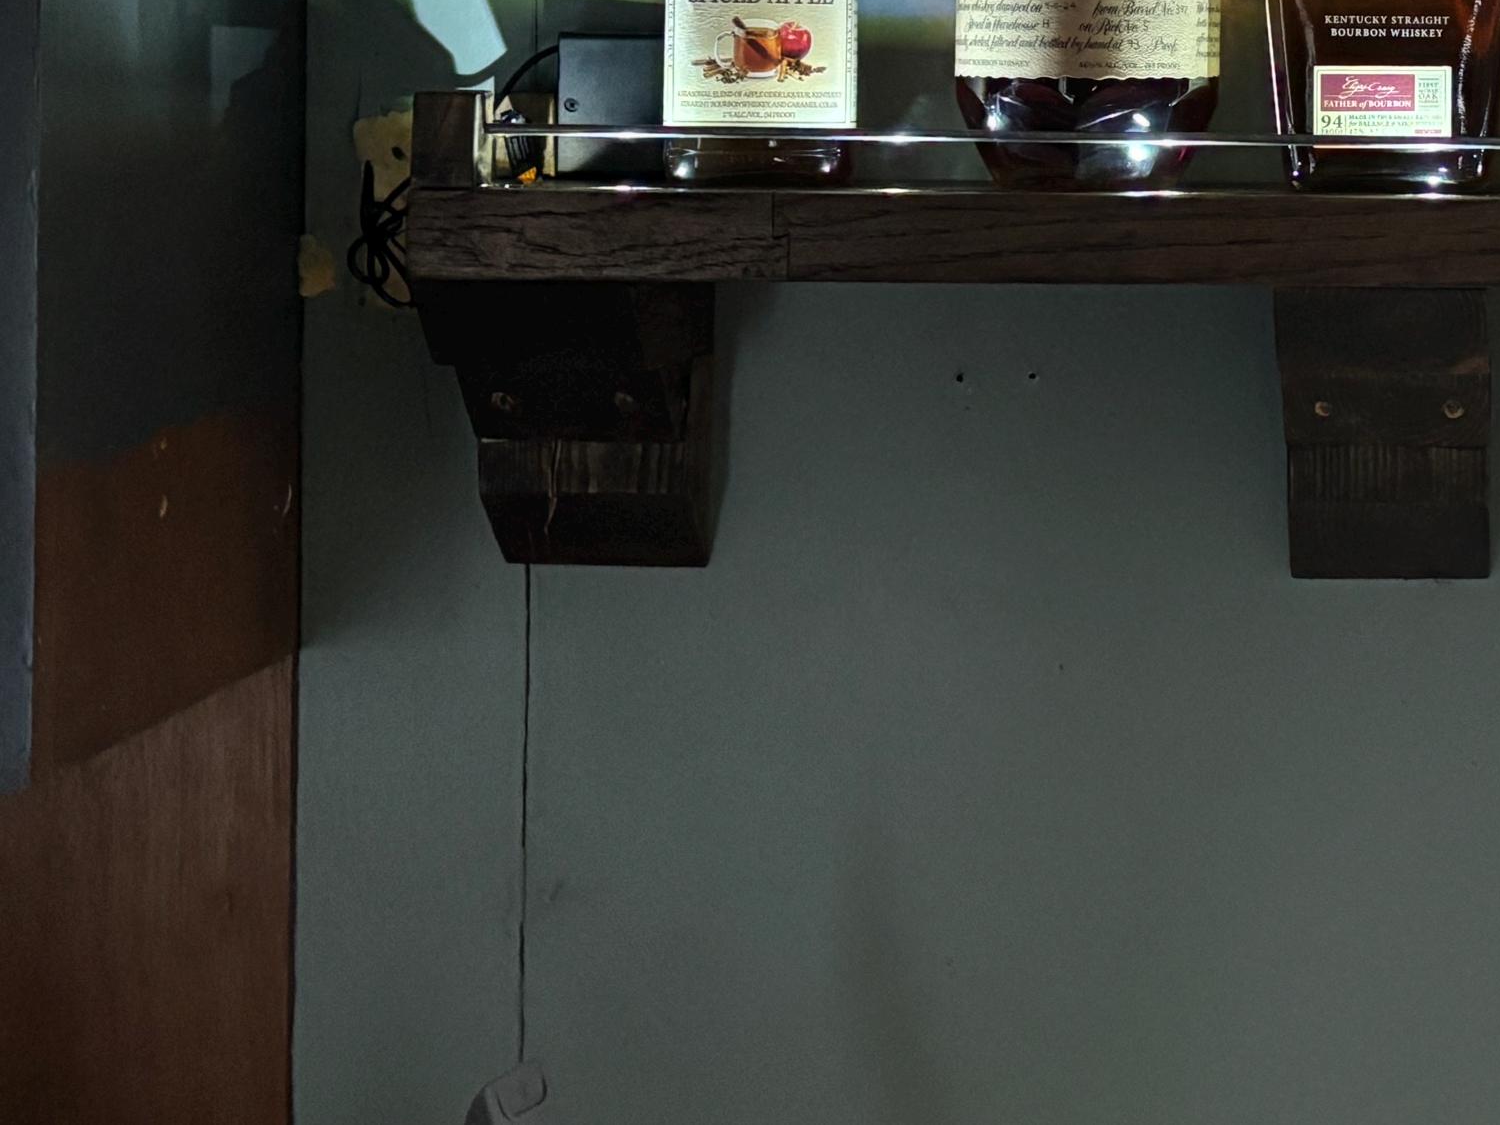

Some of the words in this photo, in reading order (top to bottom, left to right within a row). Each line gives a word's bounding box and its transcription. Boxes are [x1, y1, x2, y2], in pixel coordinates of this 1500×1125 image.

[1324, 15, 1388, 25] KENTUCKY
[1391, 15, 1450, 26] STRAIGHT
[1330, 28, 1387, 37] BOURBON
[1390, 28, 1444, 38] WHISKEY
[1323, 100, 1357, 108] FATHER
[1358, 99, 1368, 110] of
[1368, 100, 1413, 108] BOURBON
[1321, 114, 1343, 129] 94
